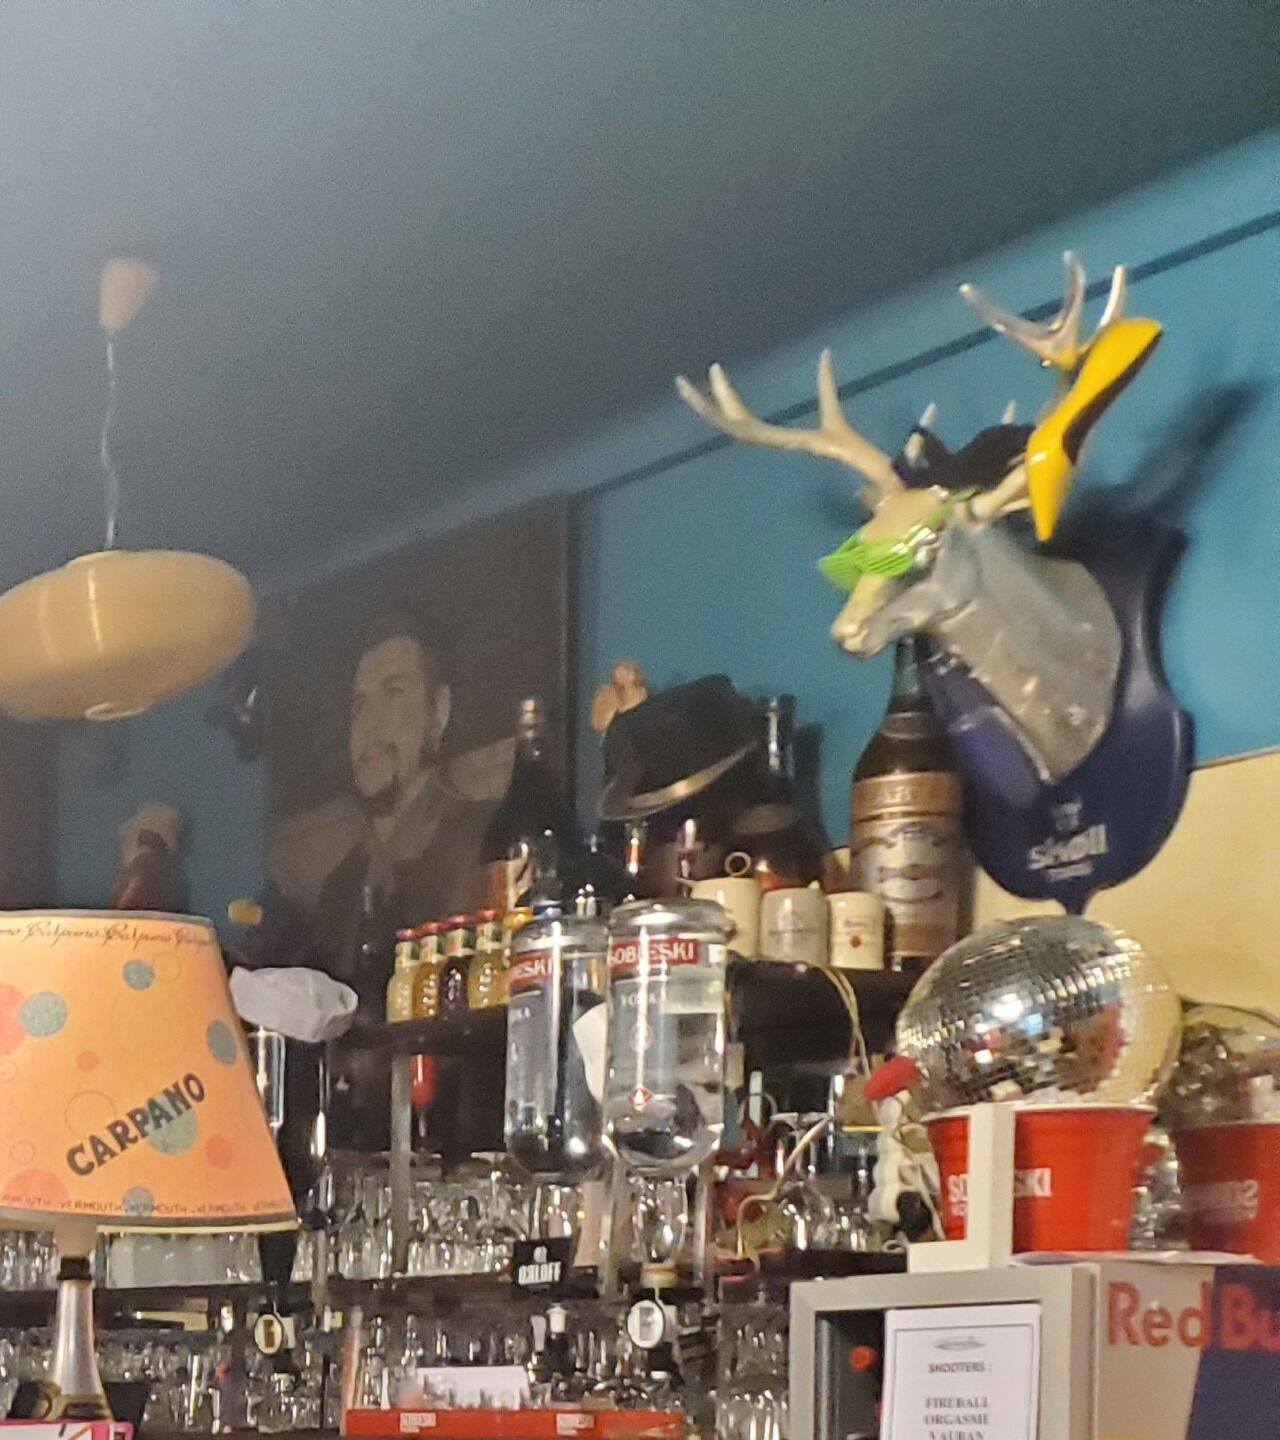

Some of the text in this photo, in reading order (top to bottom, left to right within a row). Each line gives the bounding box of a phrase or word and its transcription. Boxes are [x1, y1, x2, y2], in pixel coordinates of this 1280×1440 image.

[66, 1072, 205, 1176] CARPANO
[1107, 1280, 1213, 1348] Red
[925, 1396, 989, 1408] FIREBALL
